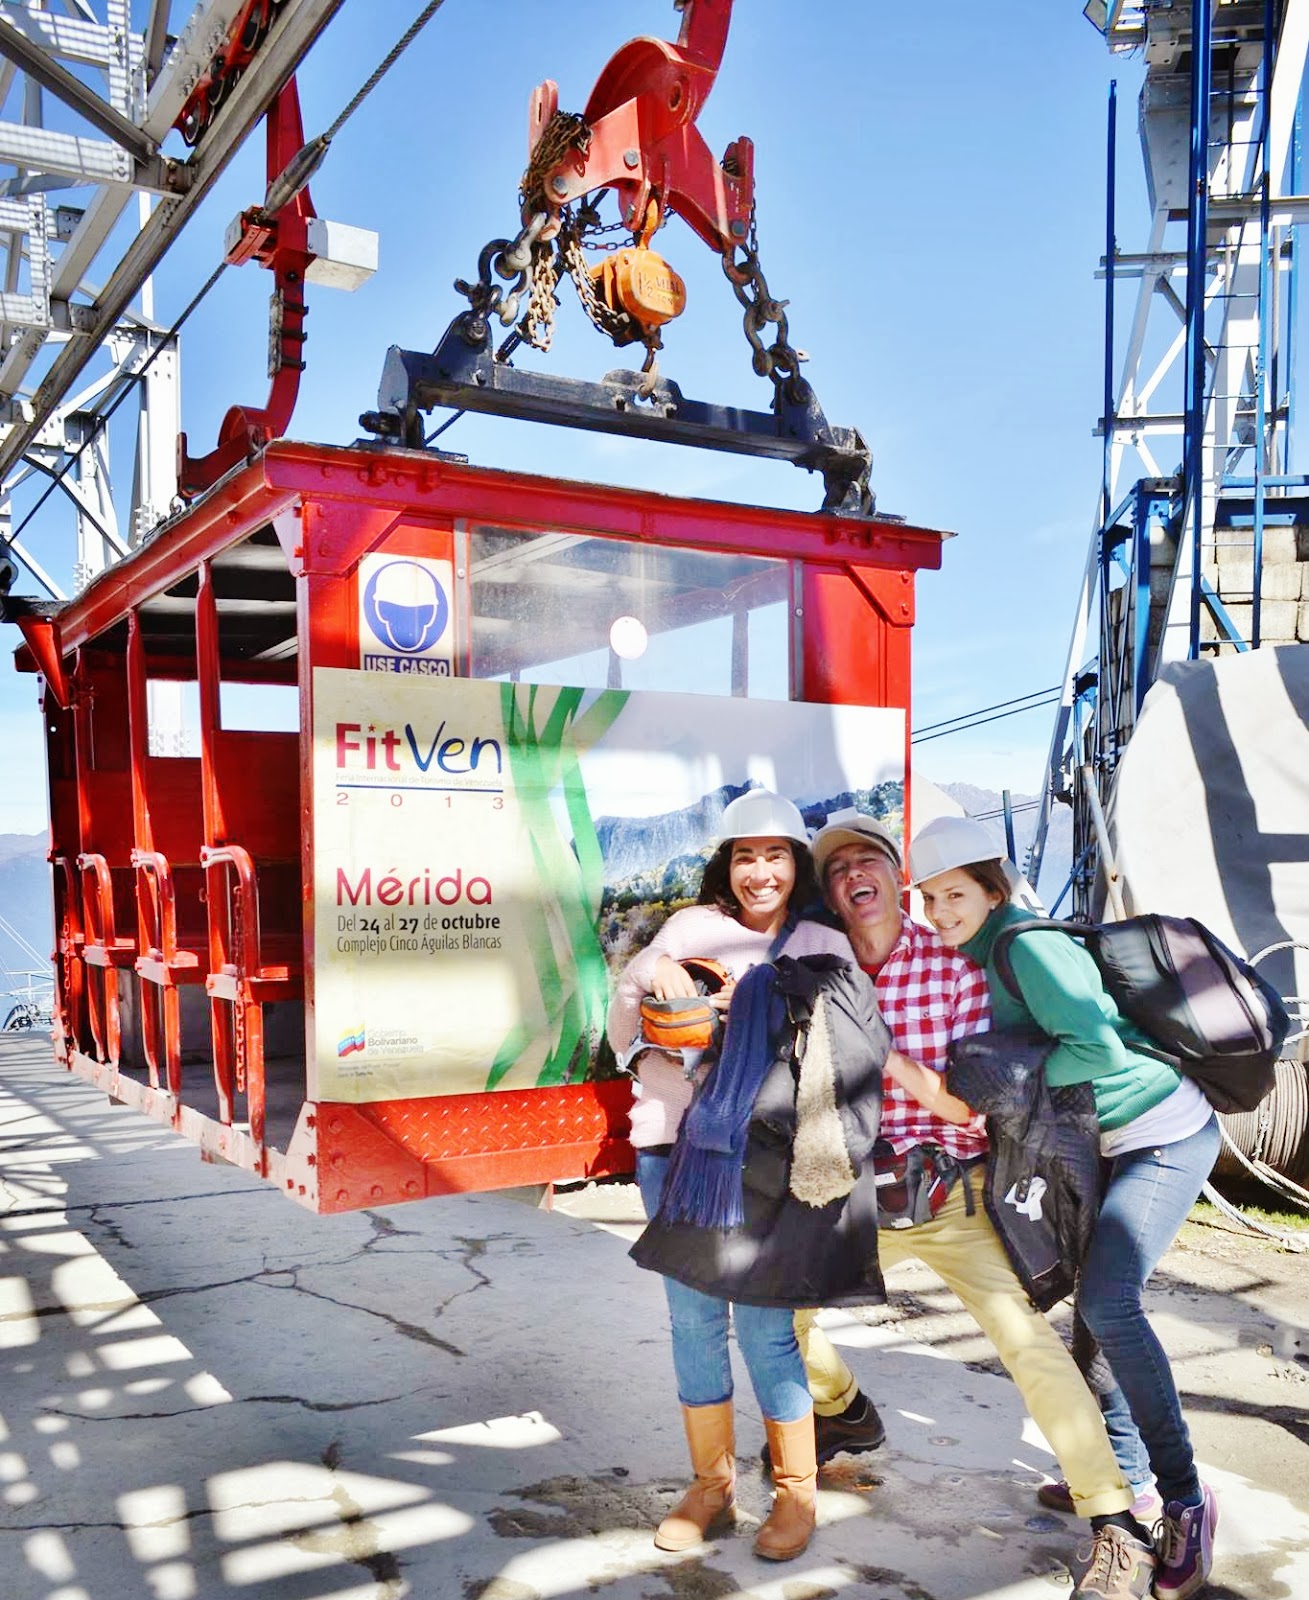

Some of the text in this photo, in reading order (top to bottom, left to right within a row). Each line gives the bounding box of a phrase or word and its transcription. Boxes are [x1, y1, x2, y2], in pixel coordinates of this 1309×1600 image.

[366, 656, 448, 677] USE CASCO
[336, 720, 502, 774] FitVen
[336, 867, 492, 906] Mérida
[337, 913, 501, 935] Del 24 al 27 de octubre
[337, 933, 502, 956] Complejo Cinco Águilas Blancas
[367, 1037, 418, 1047] Bolivariano
